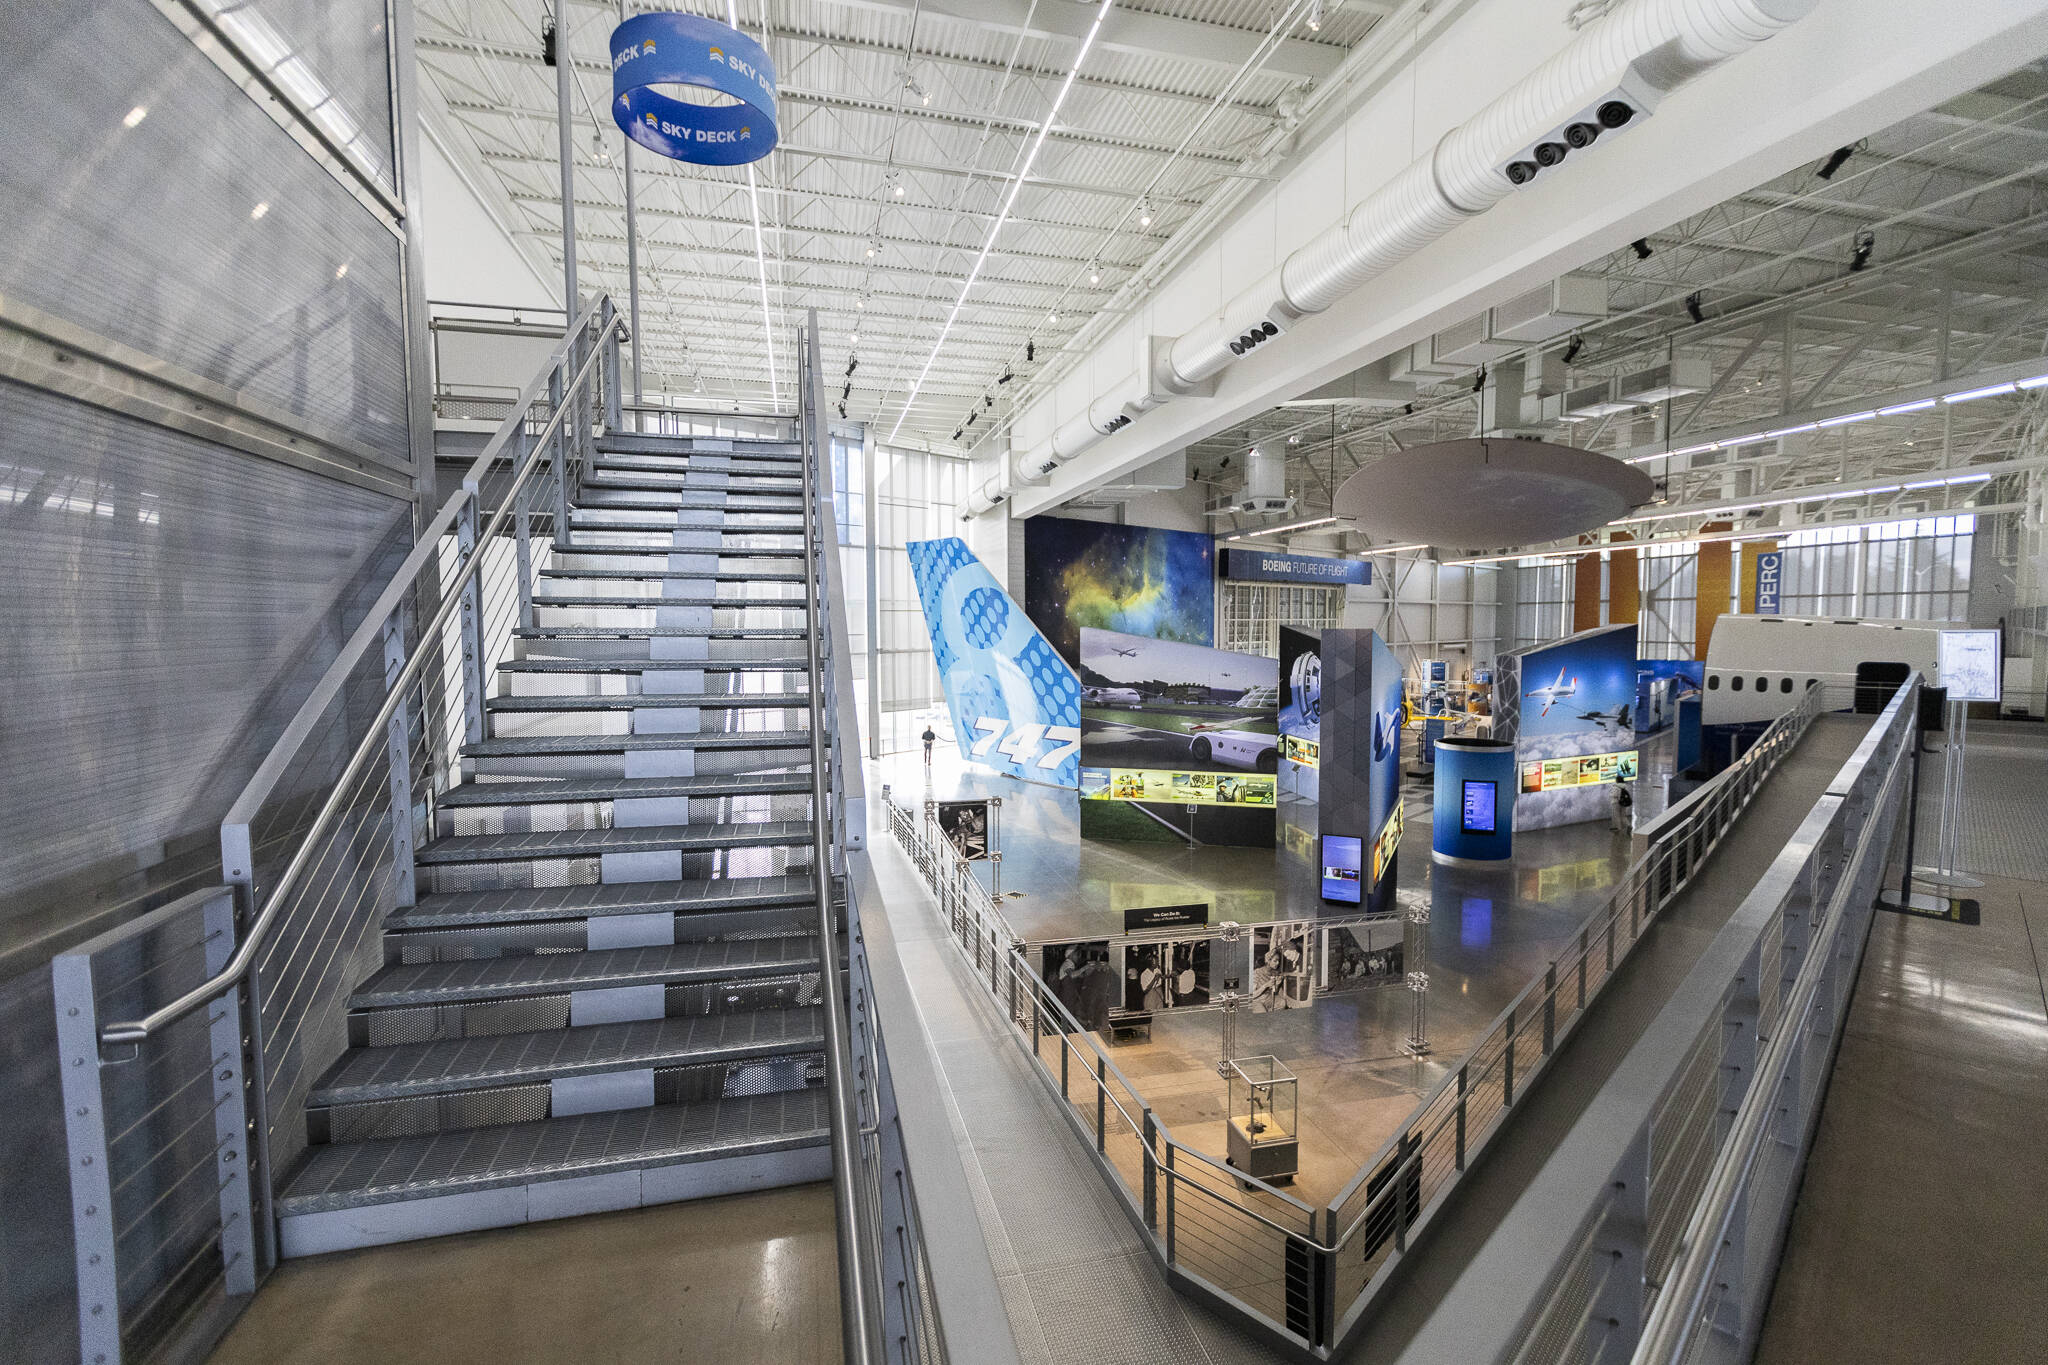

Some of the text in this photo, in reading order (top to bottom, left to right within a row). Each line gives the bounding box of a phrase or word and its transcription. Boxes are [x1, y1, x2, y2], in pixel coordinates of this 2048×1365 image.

[614, 44, 639, 72] DECK
[729, 55, 757, 80] SKY
[662, 121, 736, 143] SKY DECK
[1263, 560, 1348, 577] BOEING FUTURE OF FLIGHT
[970, 716, 1081, 770] 747
